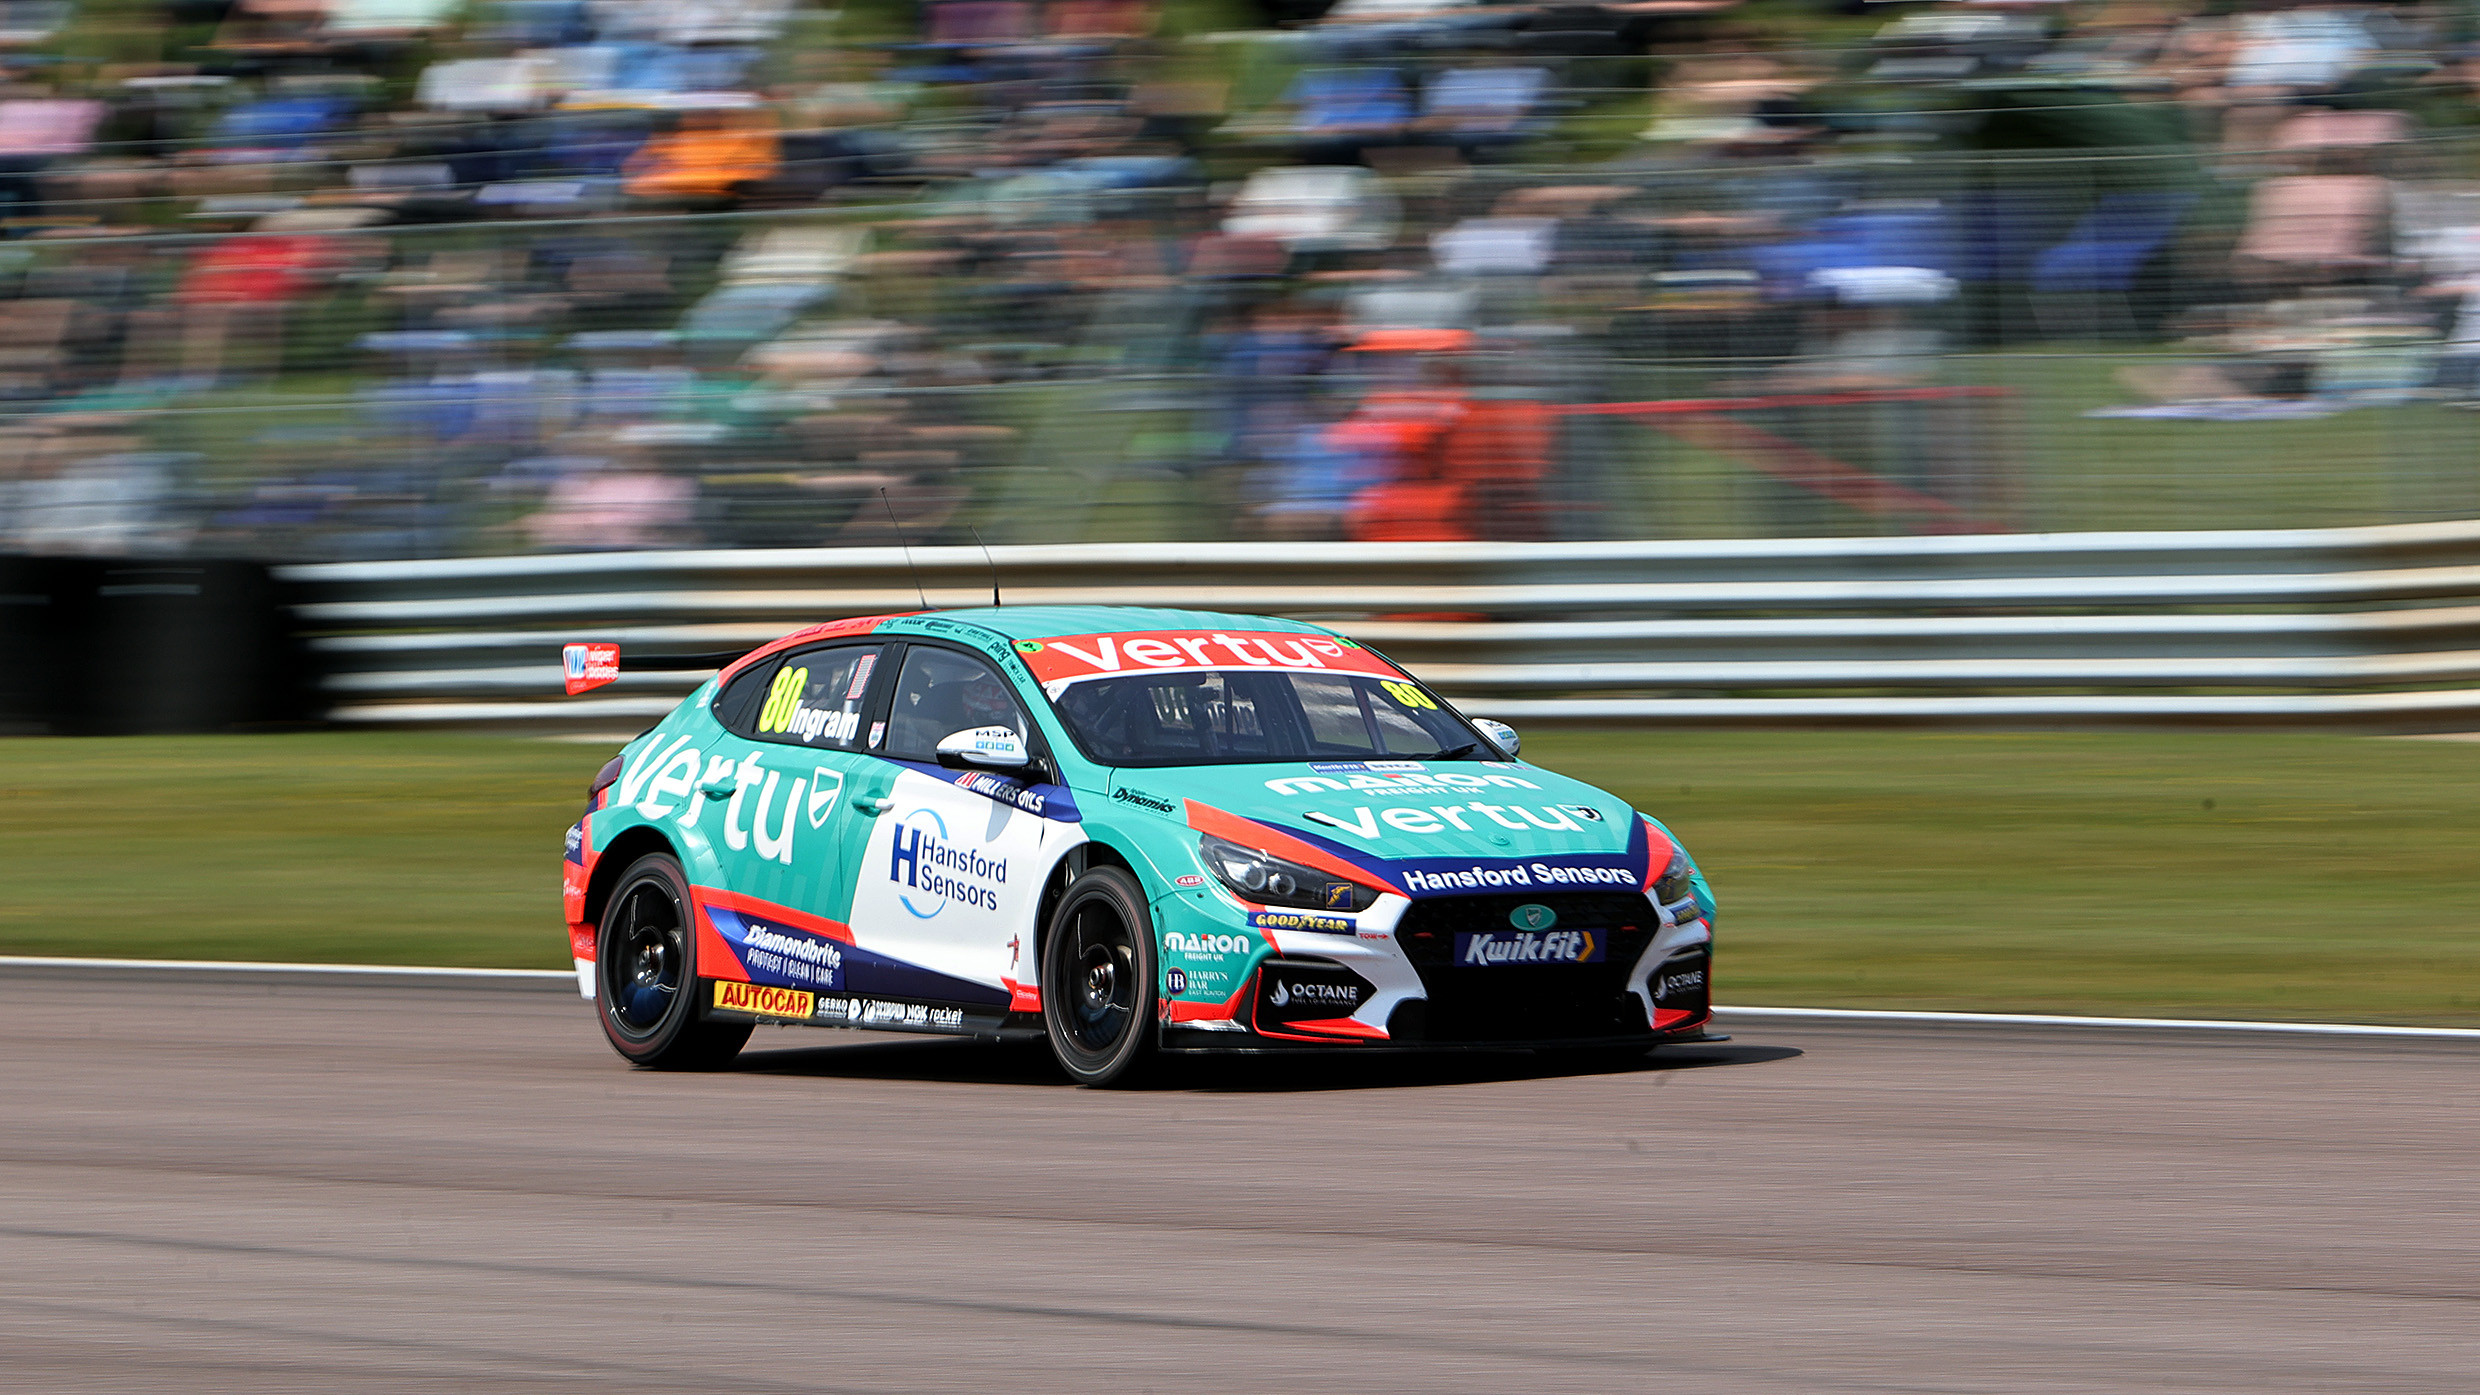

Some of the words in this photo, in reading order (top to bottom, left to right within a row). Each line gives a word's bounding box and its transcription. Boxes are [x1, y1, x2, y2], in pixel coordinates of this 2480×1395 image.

[759, 666, 808, 734] 80
[1380, 680, 1438, 710] 80
[787, 699, 860, 743] Ingram
[976, 730, 1015, 738] MSP
[972, 776, 1021, 803] MILLERS
[1018, 790, 1046, 813] OILS
[1112, 787, 1176, 813] Dynamics
[1362, 786, 1449, 797] FREIGHT
[1449, 786, 1486, 795] UK
[922, 834, 1007, 883] Hansford
[921, 864, 997, 911] Sensors
[1402, 865, 1534, 892] Hansford
[1530, 863, 1638, 886] Sensors
[1256, 914, 1348, 931] GOODYEAR
[746, 947, 783, 974] PROTECT
[815, 966, 834, 987] CARE
[1184, 952, 1213, 962] FREIGHT
[1213, 954, 1224, 962] UK
[722, 983, 808, 1015] AUTOCAR
[1189, 980, 1208, 990] BAR
[1291, 983, 1357, 1001] OCTANE
[929, 1006, 963, 1025] rocket
